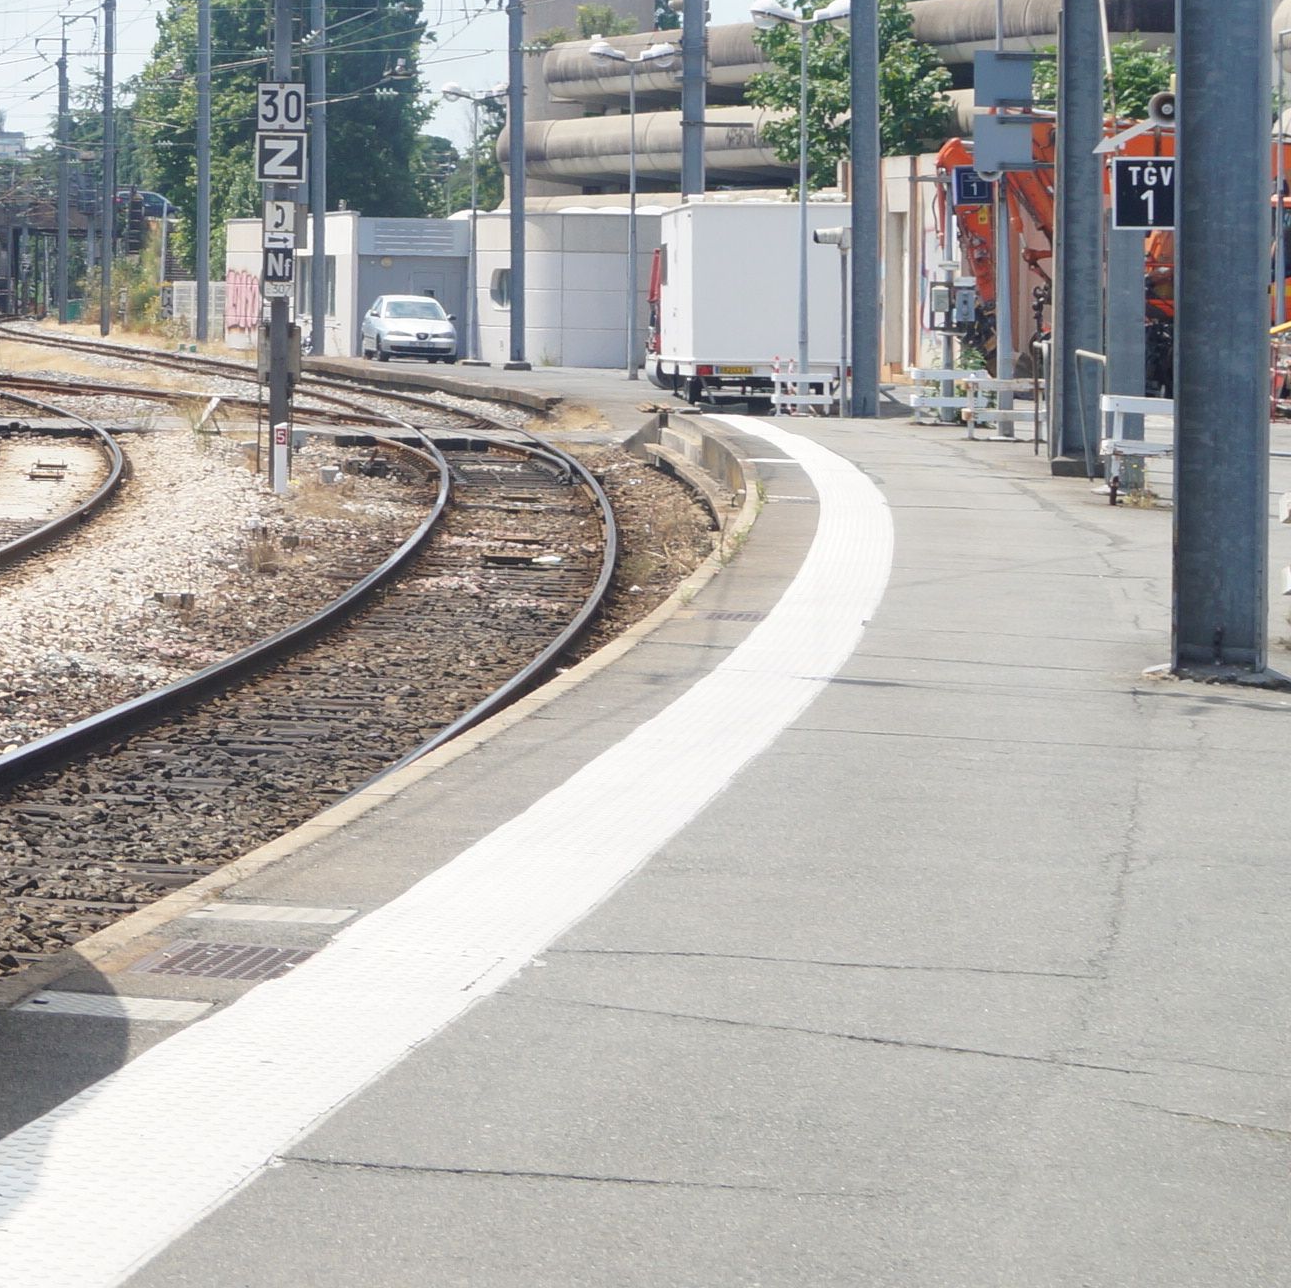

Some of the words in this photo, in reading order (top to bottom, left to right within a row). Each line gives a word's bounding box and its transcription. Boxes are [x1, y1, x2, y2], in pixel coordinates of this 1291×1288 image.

[261, 90, 302, 123] 30
[263, 139, 298, 175] Z
[1127, 166, 1173, 186] TGV
[970, 182, 978, 196] 1
[1140, 189, 1154, 221] 1
[267, 253, 292, 276] Nf
[277, 430, 285, 443] 5
